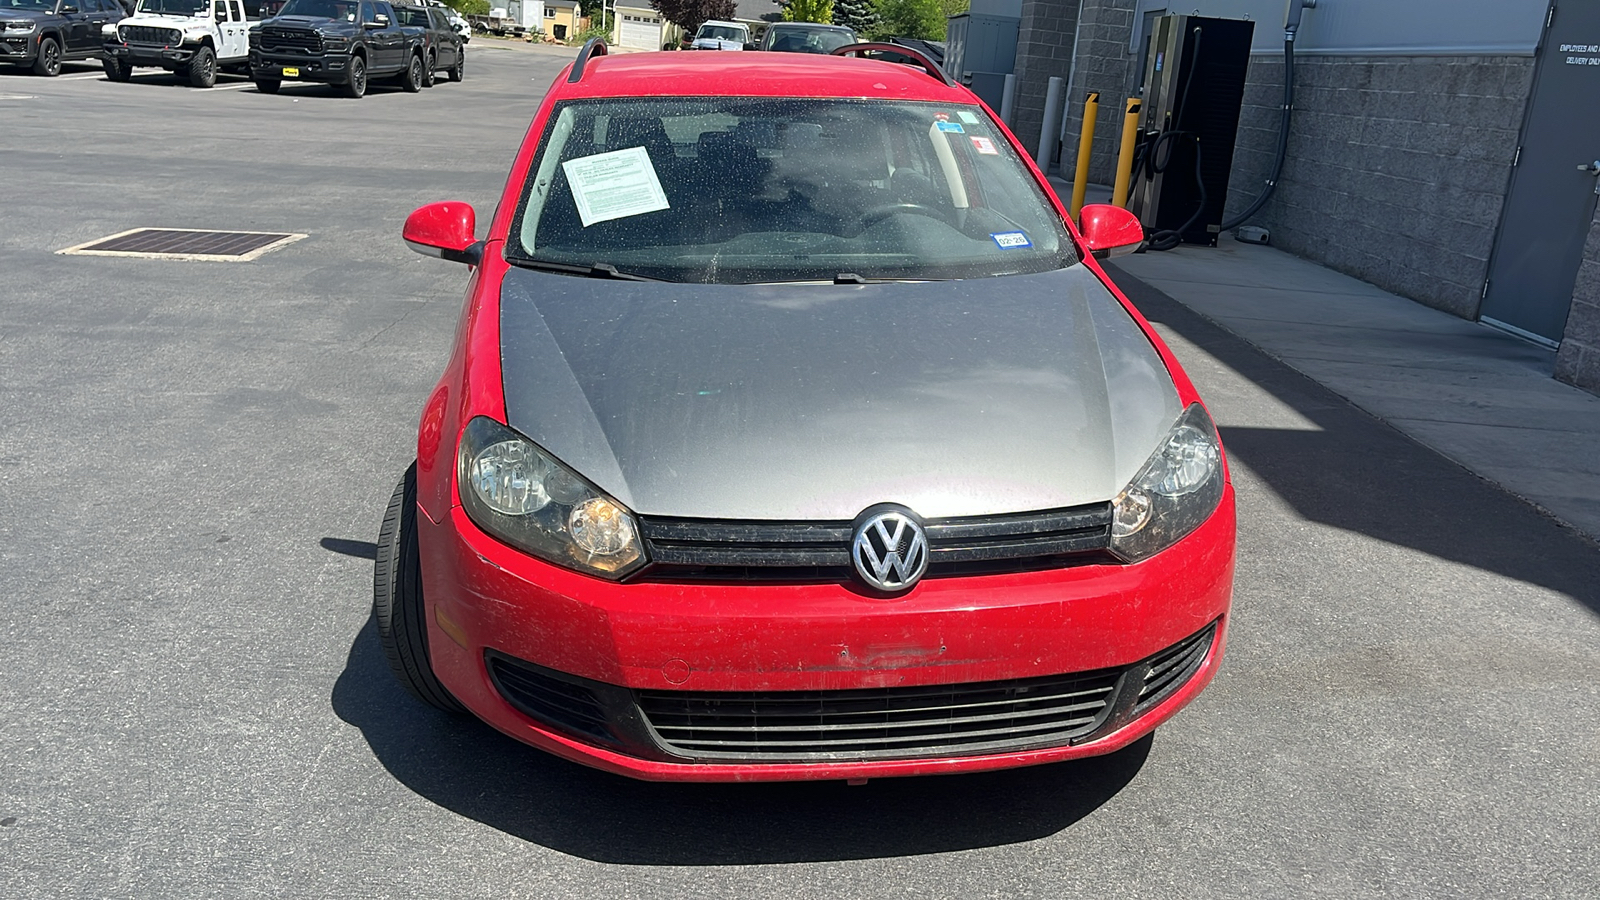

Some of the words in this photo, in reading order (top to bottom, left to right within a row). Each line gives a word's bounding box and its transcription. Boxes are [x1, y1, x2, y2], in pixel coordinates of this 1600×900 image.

[1560, 44, 1587, 53] EMPLOYEES
[1587, 45, 1598, 53] AND
[1566, 56, 1588, 65] DELIVERY
